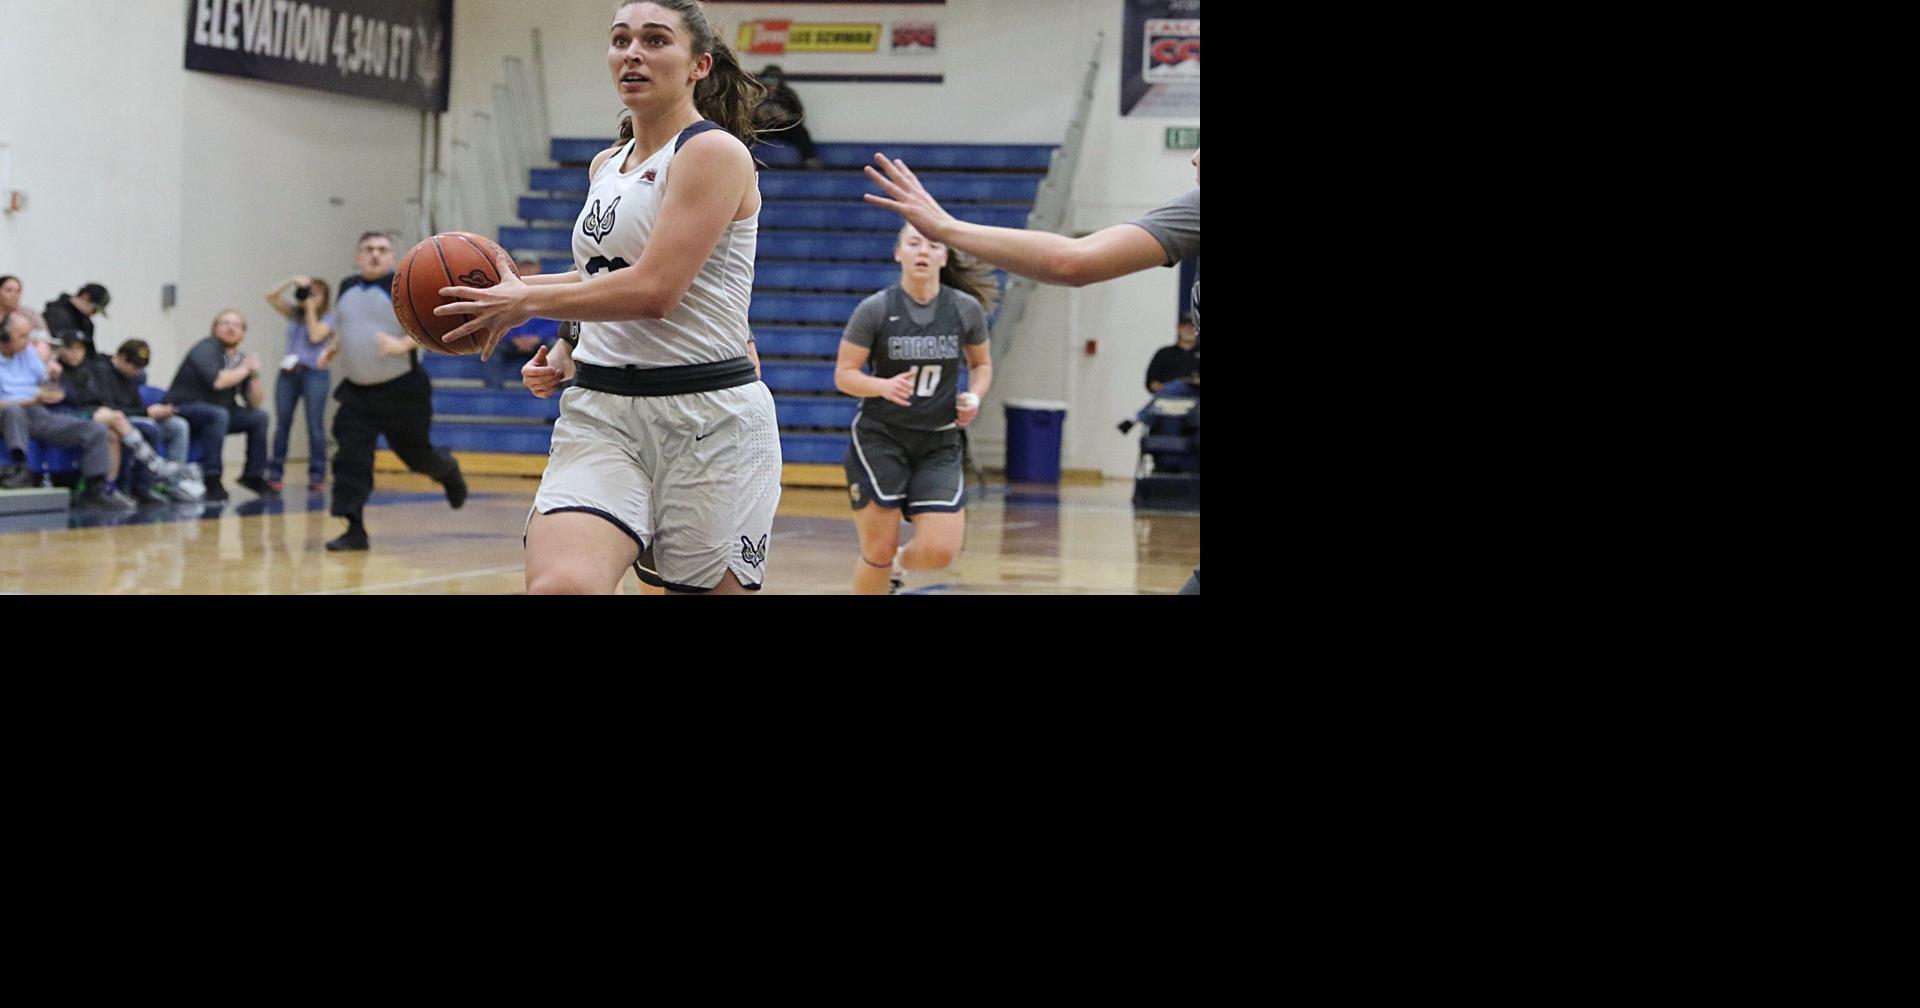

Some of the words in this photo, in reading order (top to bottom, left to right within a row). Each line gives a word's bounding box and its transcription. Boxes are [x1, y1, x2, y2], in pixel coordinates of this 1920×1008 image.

[194, 0, 331, 65] ELEVATION
[331, 13, 388, 77] 4,340
[389, 22, 412, 82] FT
[888, 335, 959, 359] CORBAN
